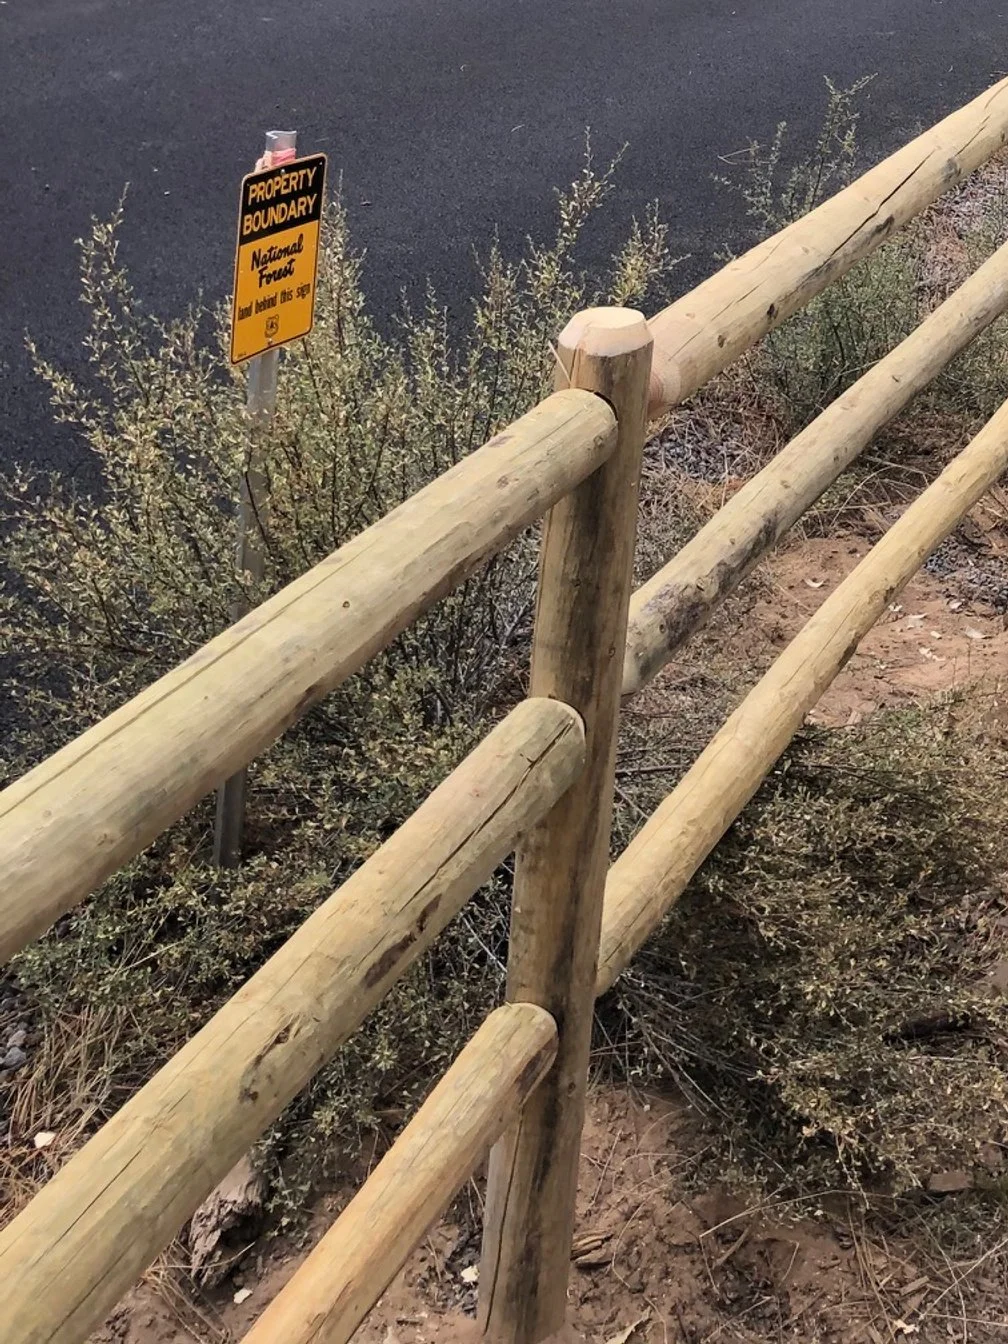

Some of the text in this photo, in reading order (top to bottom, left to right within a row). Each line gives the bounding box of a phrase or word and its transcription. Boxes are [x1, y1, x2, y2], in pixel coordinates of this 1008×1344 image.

[248, 166, 317, 206] PROPERTY
[242, 193, 317, 236] BOUNDARY
[251, 233, 304, 272] National
[258, 258, 296, 289] Forest
[255, 292, 278, 314] behind
[280, 287, 293, 304] this
